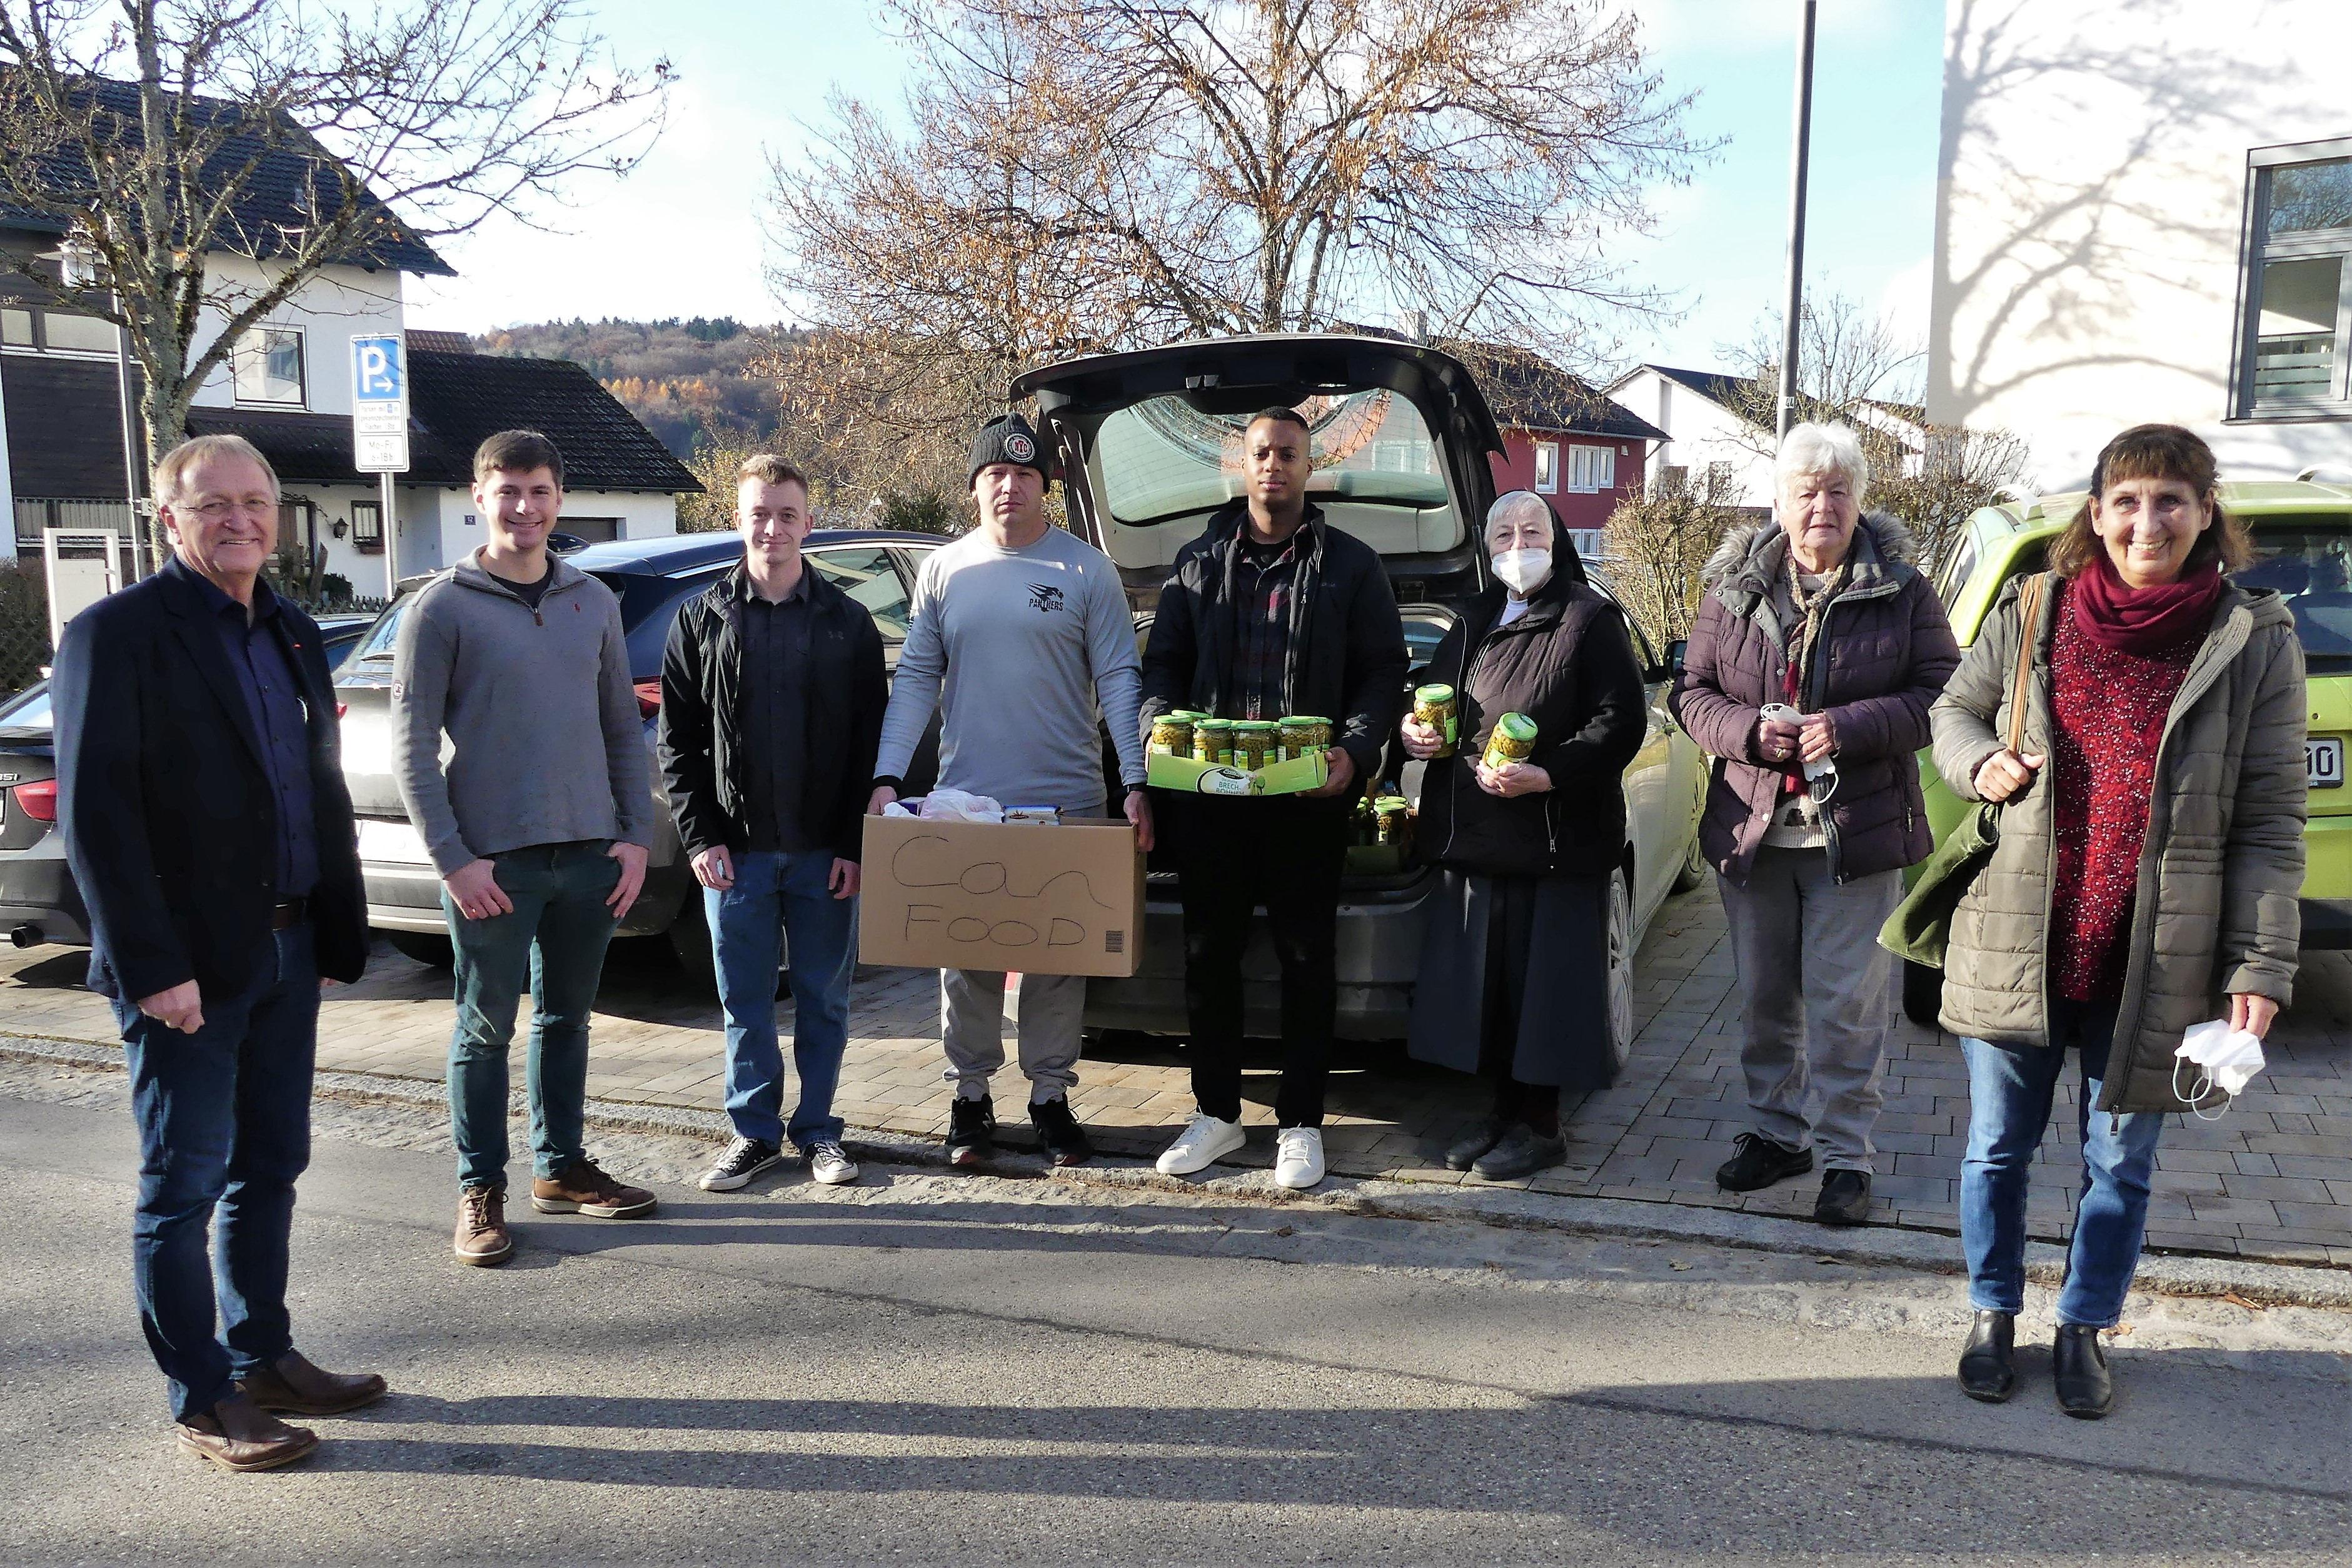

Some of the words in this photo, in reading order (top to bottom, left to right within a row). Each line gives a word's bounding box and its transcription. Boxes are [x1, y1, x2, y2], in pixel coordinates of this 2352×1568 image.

[361, 346, 386, 393] P
[1015, 440, 1028, 453] NYC
[1029, 598, 1063, 611] PANTHERS
[1219, 781, 1241, 791] BRECH-
[892, 835, 1115, 910] Can
[905, 904, 1085, 949] FOOD
